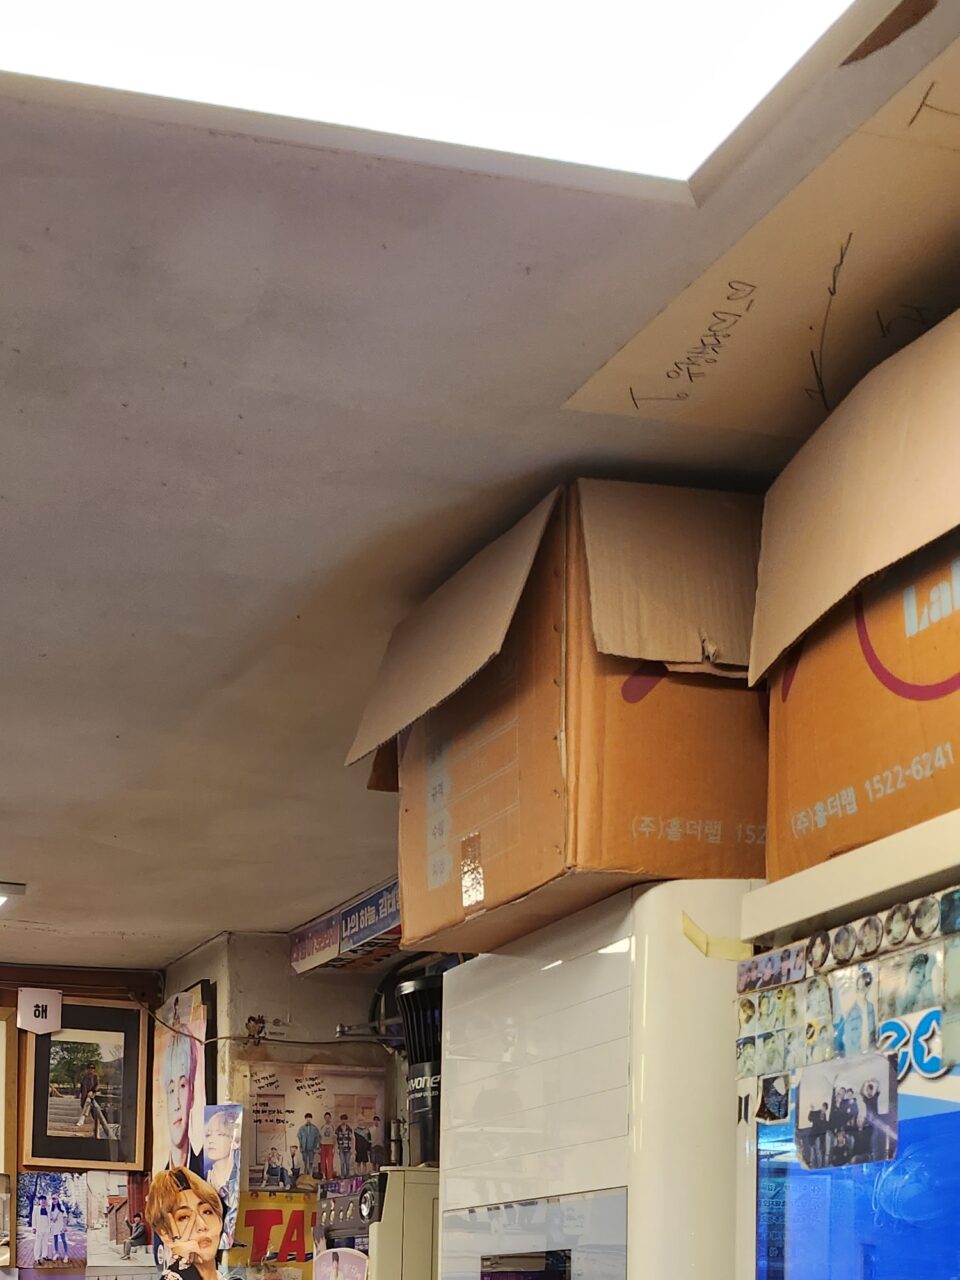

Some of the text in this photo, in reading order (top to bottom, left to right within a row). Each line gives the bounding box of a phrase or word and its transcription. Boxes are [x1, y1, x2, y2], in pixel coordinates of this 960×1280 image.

[864, 741, 955, 802] 1522-6241
[342, 912, 359, 937] 나의
[360, 906, 379, 929] 하늘,
[33, 1004, 48, 1019] 해
[245, 1209, 317, 1263] TA
